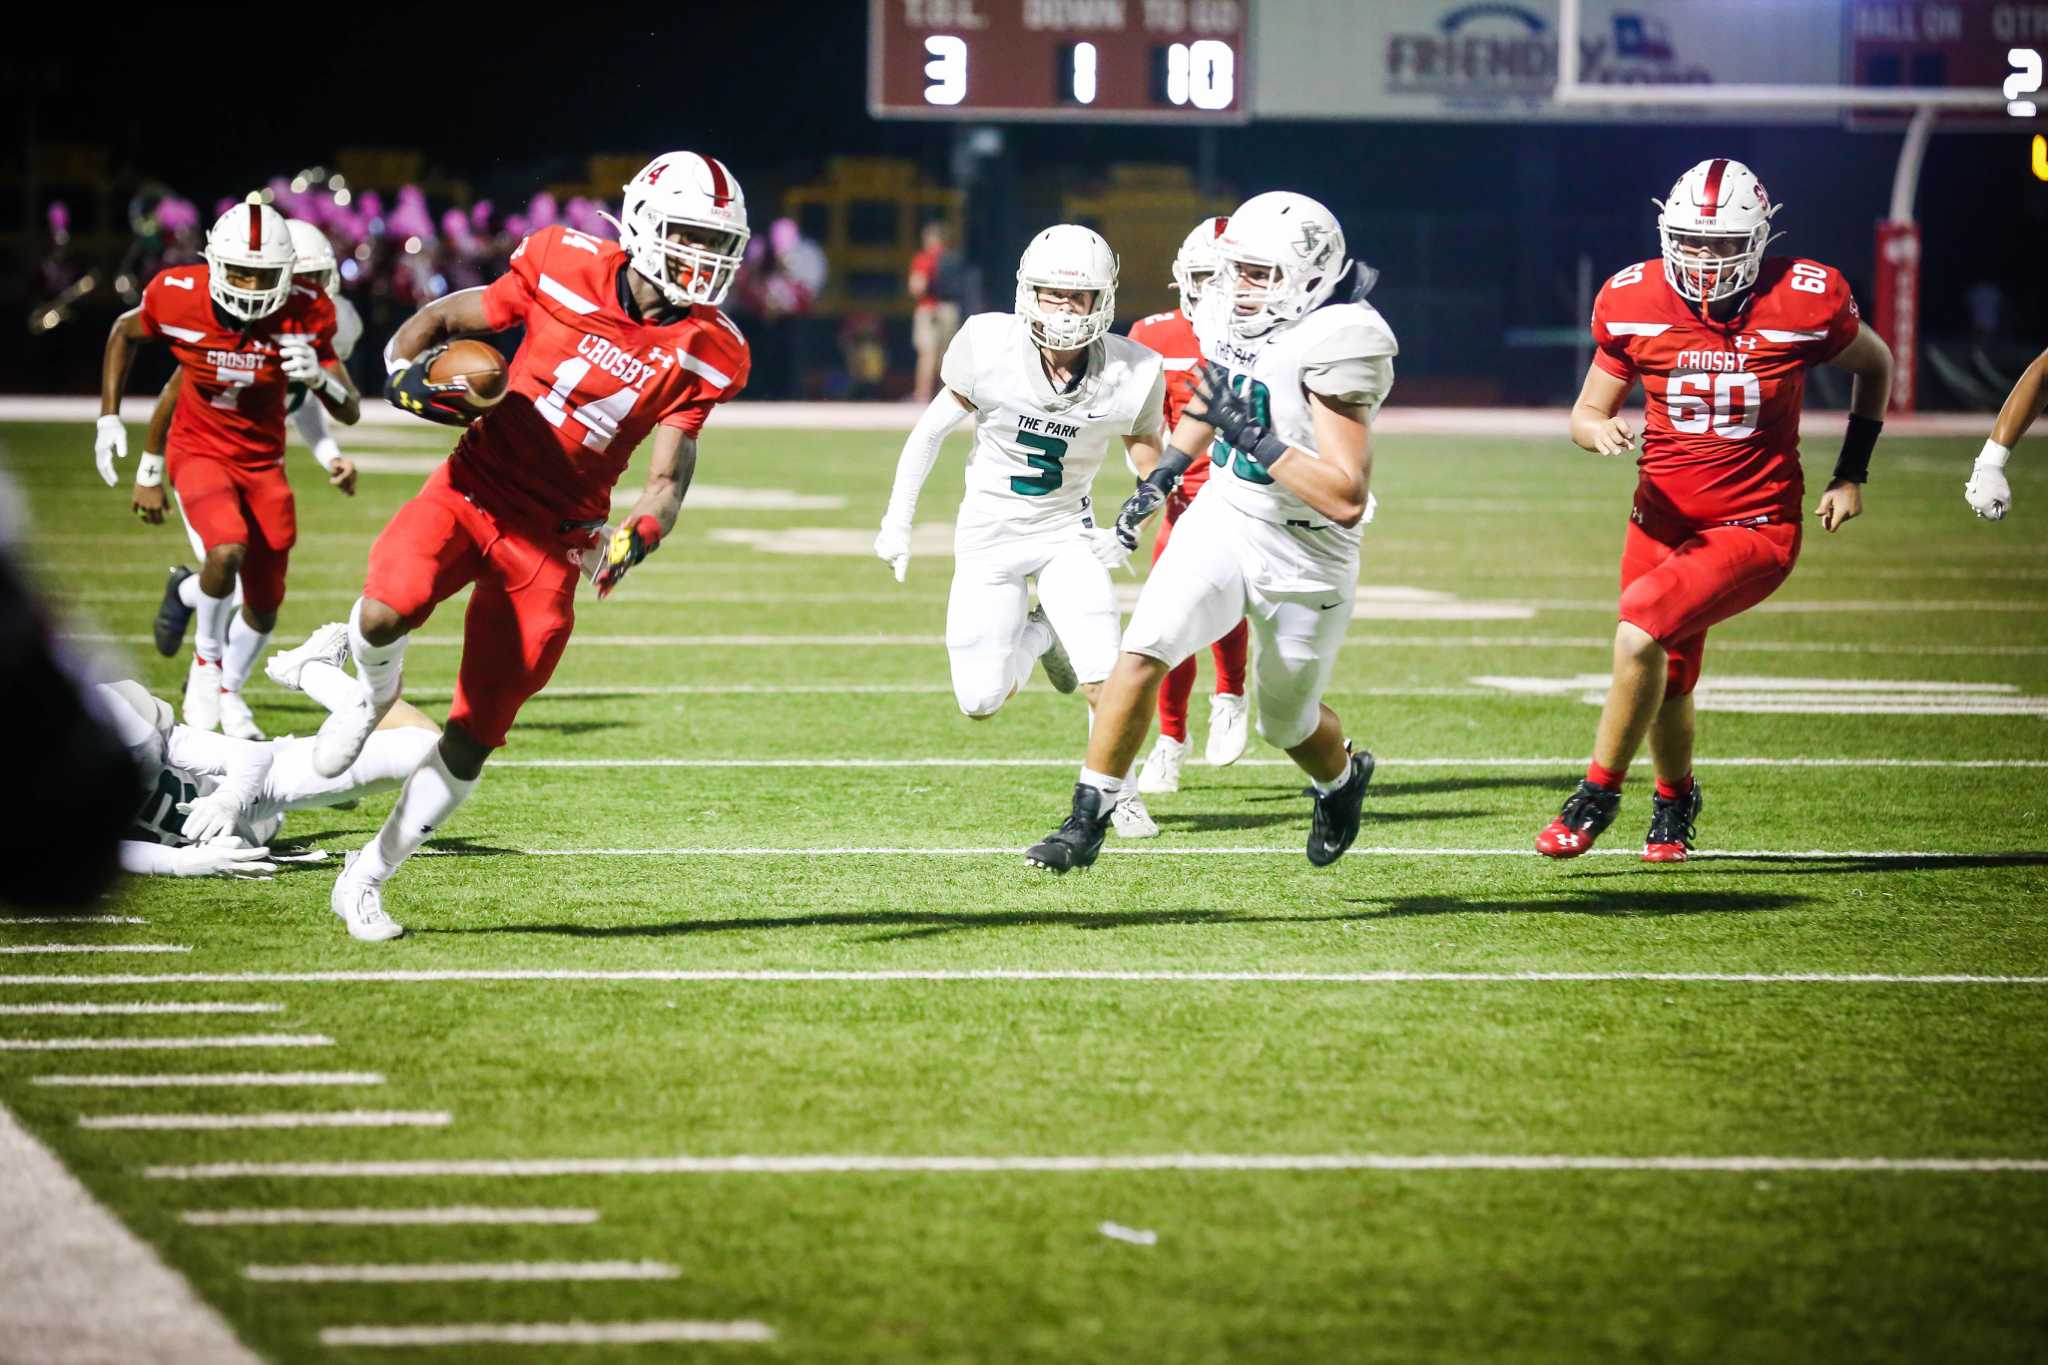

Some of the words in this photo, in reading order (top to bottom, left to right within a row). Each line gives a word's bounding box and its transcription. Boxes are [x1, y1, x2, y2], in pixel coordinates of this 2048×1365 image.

[923, 35, 967, 105] 3
[1073, 42, 1096, 104] 1
[1167, 40, 1234, 110] 10
[1386, 34, 1606, 80] FRIENDY
[2003, 48, 2043, 117] 2
[1791, 263, 1827, 294] 60
[206, 350, 267, 370] CROSBY
[210, 367, 256, 411] 7
[577, 334, 657, 390] CROSBY
[1677, 350, 1749, 372] CROSBY
[534, 356, 641, 453] 14
[1018, 414, 1043, 431] THE
[1044, 421, 1081, 438] PARK
[1666, 370, 1760, 439] 60
[1010, 429, 1068, 496] 3
